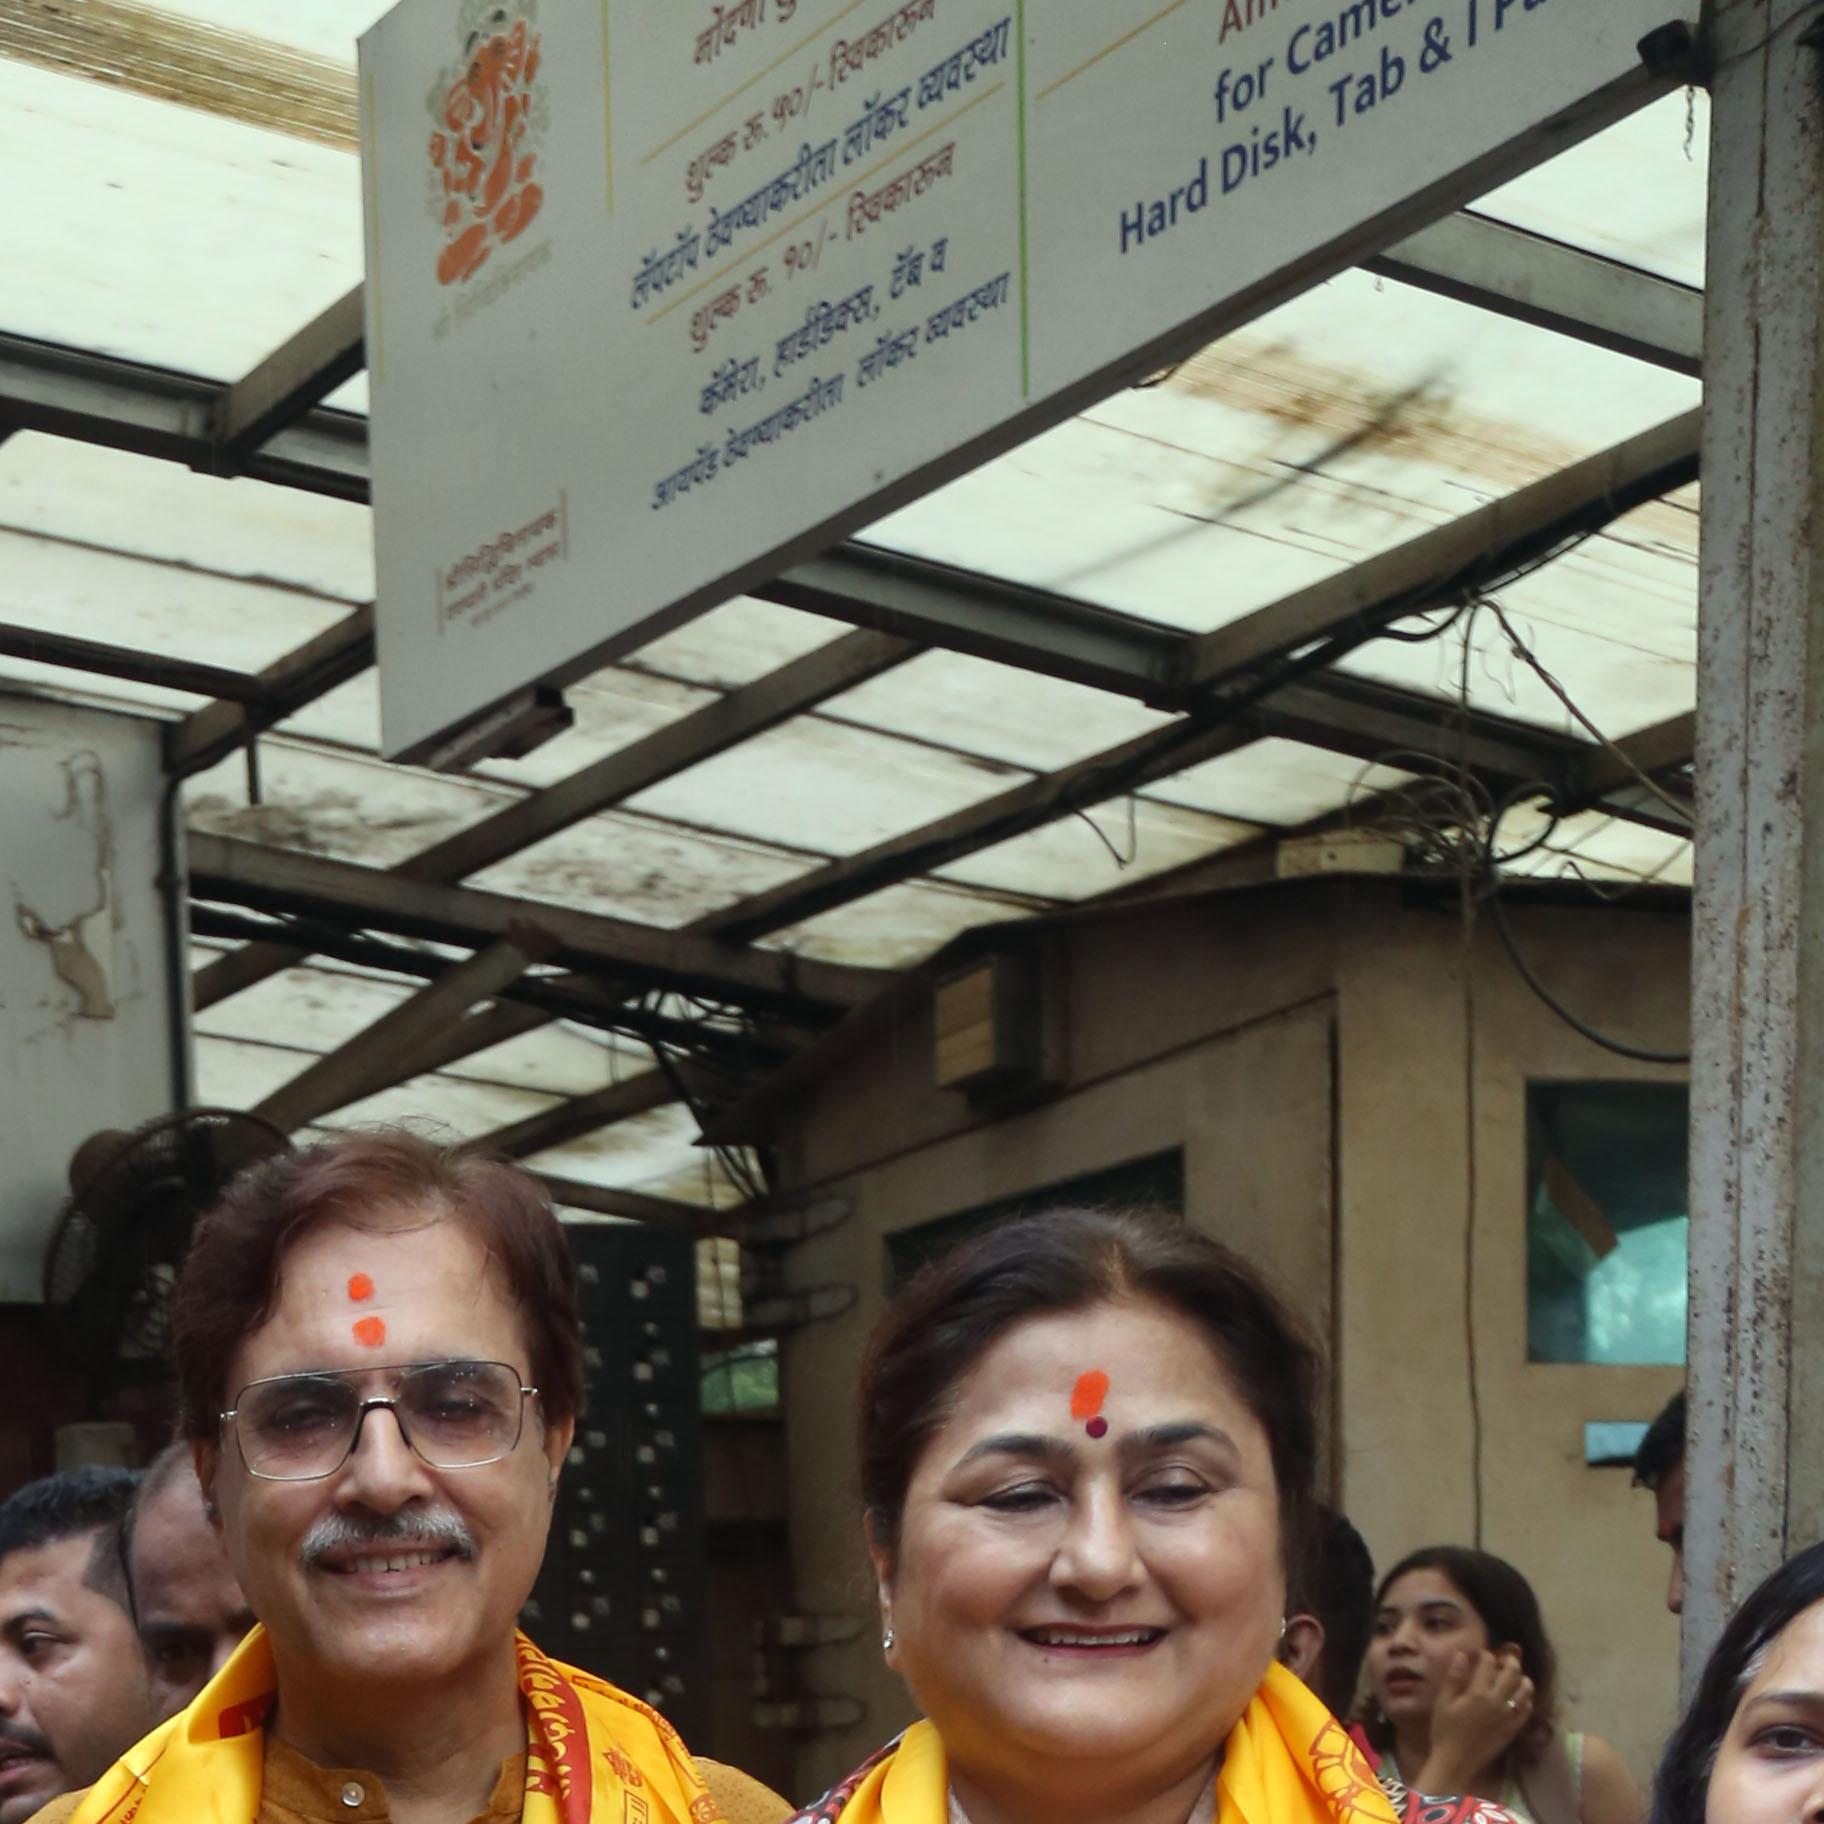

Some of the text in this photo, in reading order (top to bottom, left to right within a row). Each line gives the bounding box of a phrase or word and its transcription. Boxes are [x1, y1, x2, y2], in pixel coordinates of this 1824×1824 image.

[1119, 158, 1209, 253] Hard
[1222, 107, 1316, 193] Disk,
[1329, 46, 1405, 126] Tab
[1419, 16, 1452, 73] &
[1214, 57, 1274, 122] for
